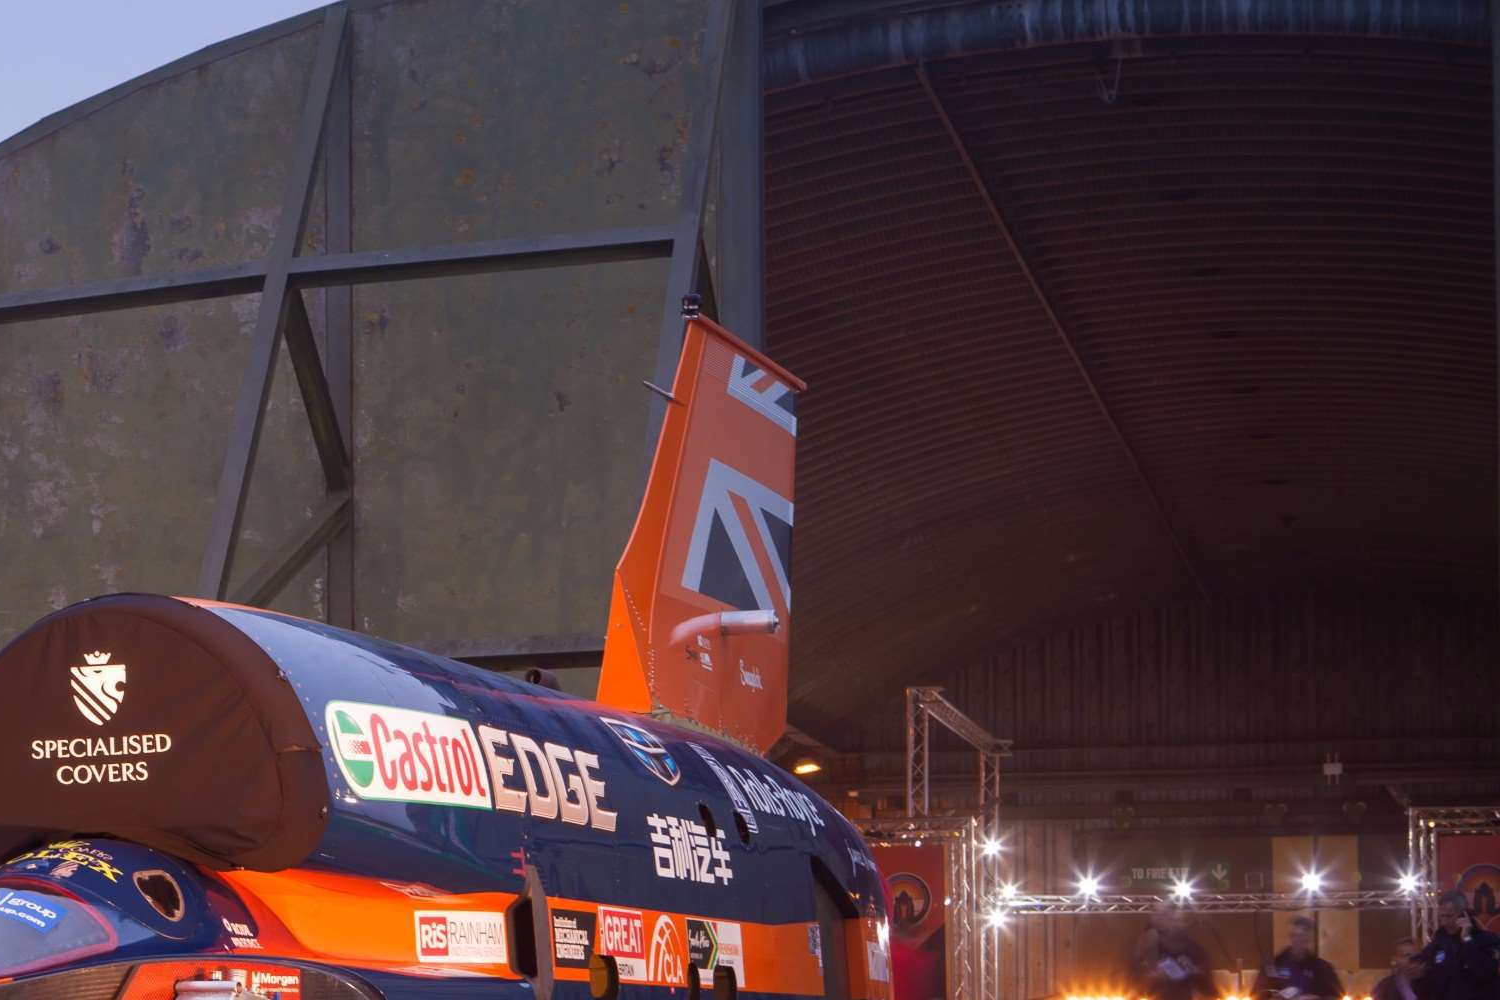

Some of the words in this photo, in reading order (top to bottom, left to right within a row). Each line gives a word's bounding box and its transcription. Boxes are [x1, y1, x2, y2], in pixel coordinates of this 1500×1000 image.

[31, 733, 171, 760] SPECIALISED
[56, 761, 149, 785] COVERS
[370, 713, 486, 798] Castrol
[477, 724, 618, 832] EDGE
[646, 813, 734, 886] 吉利汽车
[449, 920, 505, 945] RAINHAM
[605, 915, 642, 953] GREAT
[261, 972, 300, 987] Morgan
